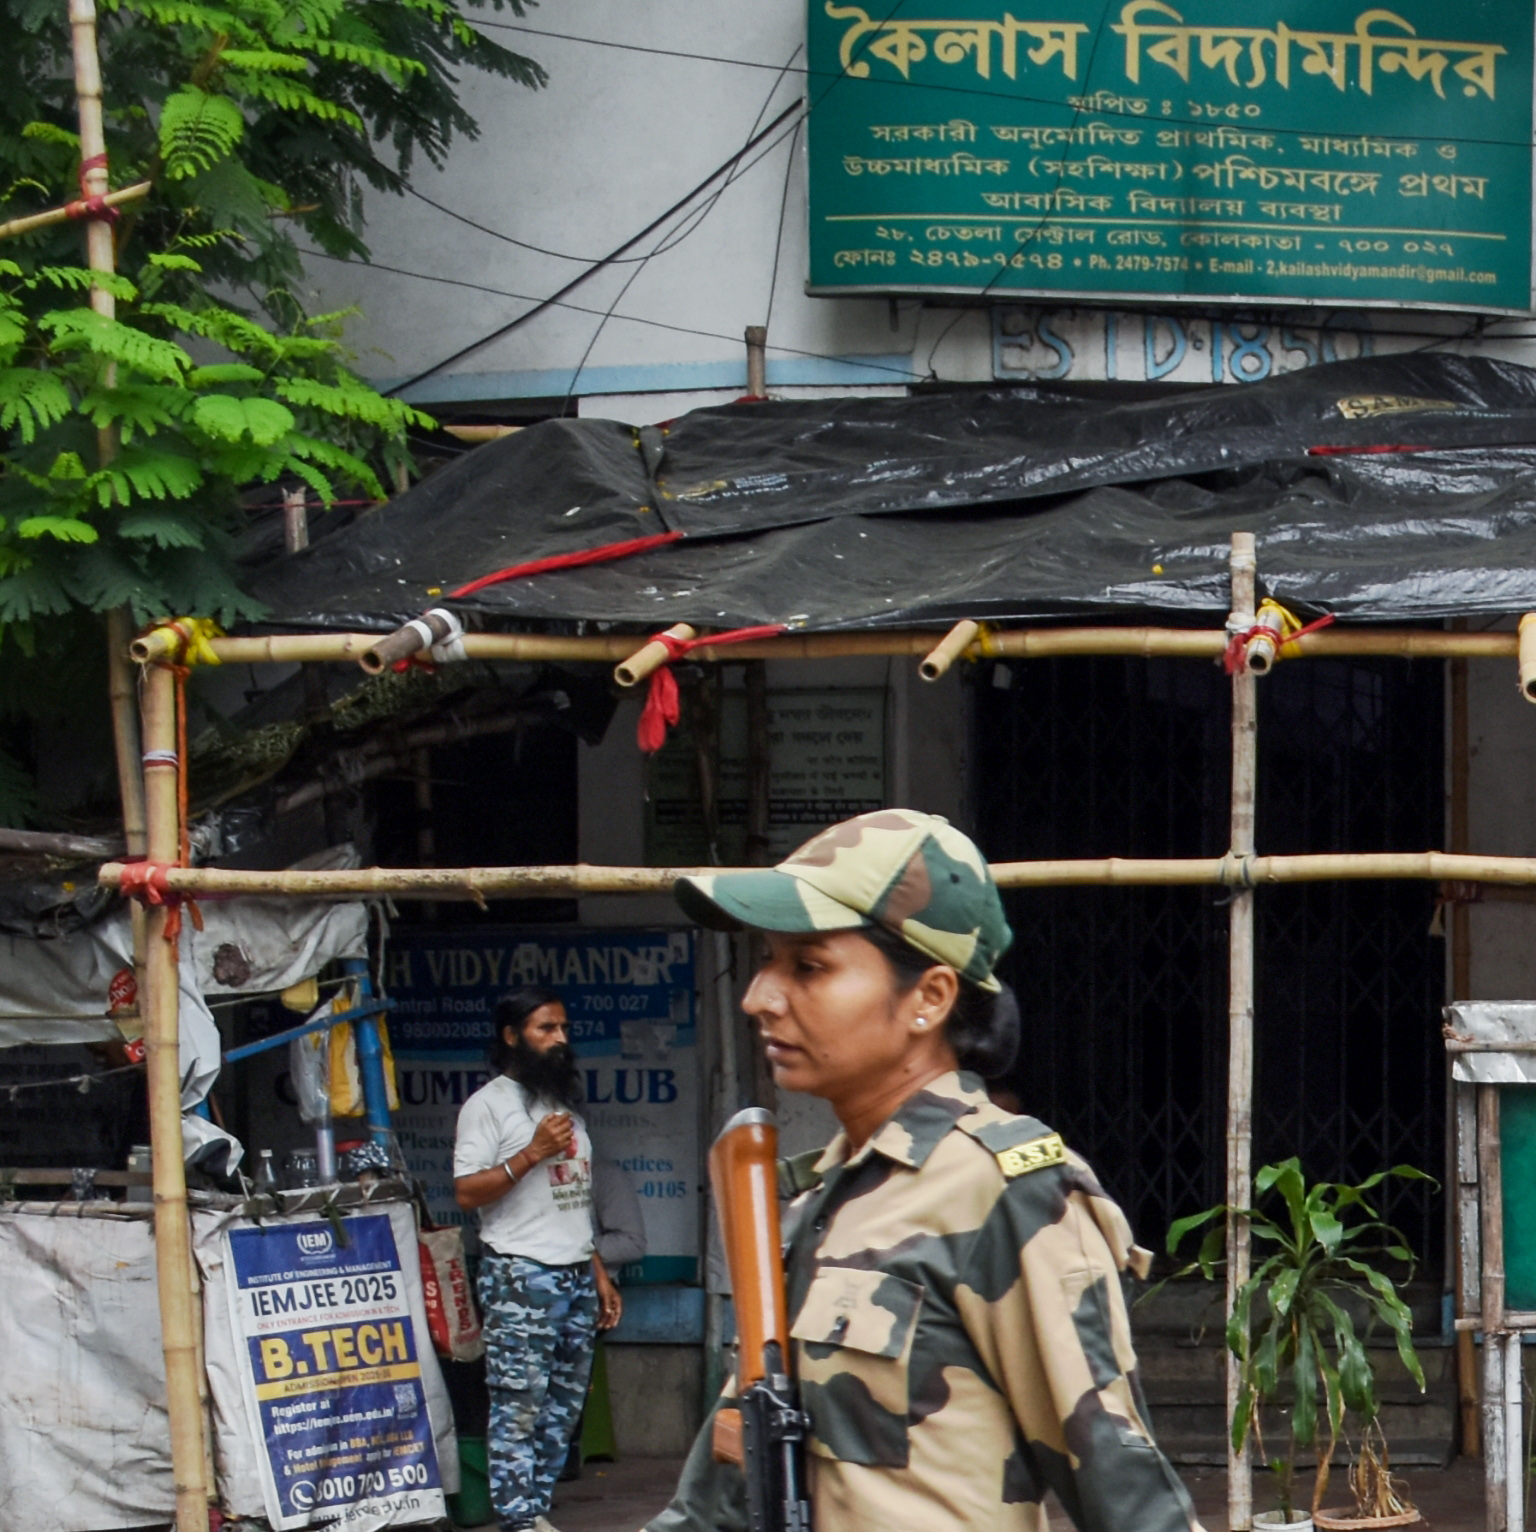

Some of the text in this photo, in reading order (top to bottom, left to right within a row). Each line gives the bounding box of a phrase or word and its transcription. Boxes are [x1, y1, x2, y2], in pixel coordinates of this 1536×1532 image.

[825, 0, 1508, 100] কৈলাস বিদ্যামন্দির
[1187, 101, 1261, 118] ১৮৫০
[869, 119, 979, 144] সরকারী
[990, 122, 1143, 149] অনুমোদিত
[1297, 136, 1420, 159] মাধ্যমিক
[1436, 145, 1458, 160] ও
[842, 153, 1010, 176] উচ্চমাধ্যমিক
[1192, 155, 1383, 197] পশ্চিমবঙ্গে
[1398, 172, 1490, 200] প্রথম
[981, 188, 1343, 222] আবাসিক বিদ্যালয় ব্যবস্থা
[925, 225, 1002, 243] চেতলা
[1179, 232, 1302, 252] কোলকাতা
[1338, 237, 1390, 253] ৭০০
[1115, 255, 1190, 272] 2479-7574
[1208, 258, 1254, 274] E-mail
[583, 996, 613, 1012] 700
[619, 995, 649, 1011] 027
[584, 1067, 679, 1105] LUB
[301, 1232, 328, 1249] IEM
[248, 1273, 282, 1285] INSTITUTE
[283, 1272, 294, 1280] OF
[341, 1275, 397, 1305] 2025
[260, 1322, 408, 1380] B.TECH
[271, 1401, 317, 1418] Register
[388, 1463, 428, 1487] 500
